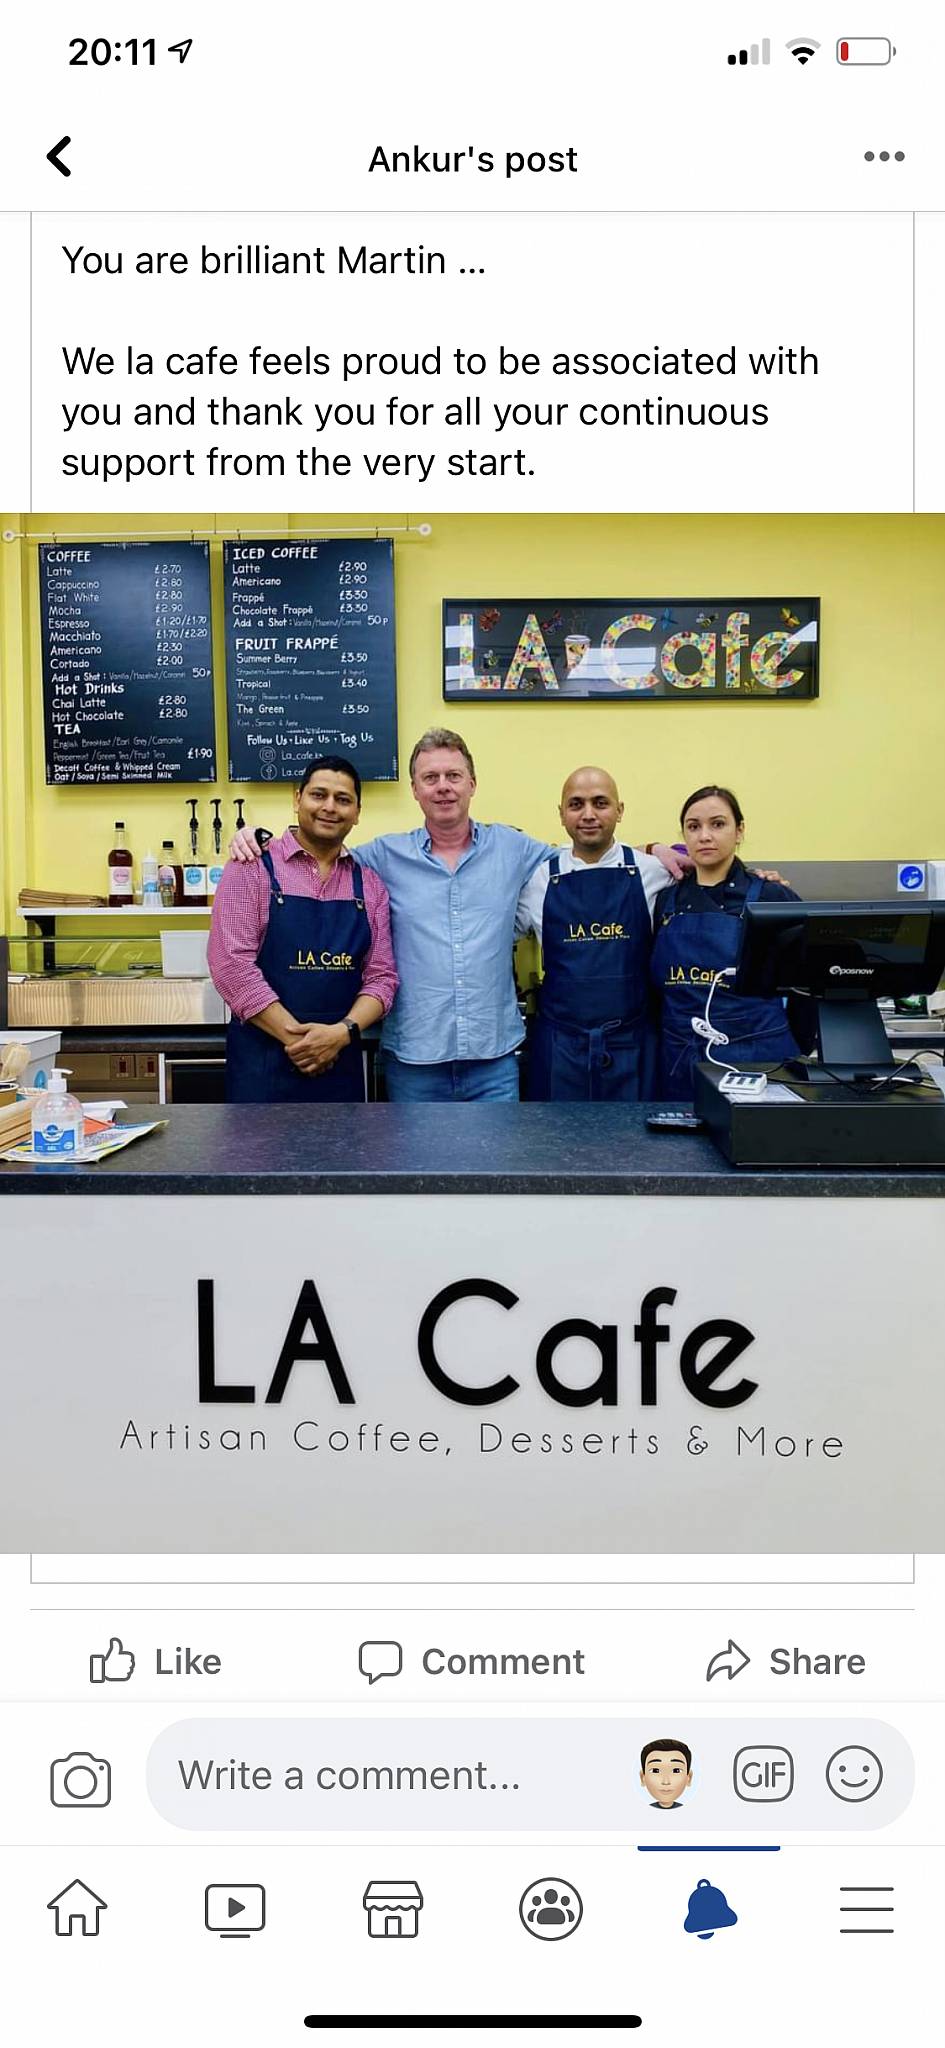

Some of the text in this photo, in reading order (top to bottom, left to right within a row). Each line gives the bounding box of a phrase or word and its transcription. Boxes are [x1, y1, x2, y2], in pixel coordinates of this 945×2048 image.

[47, 551, 91, 562] COFFEE
[232, 547, 318, 560] ICED COFFEE
[47, 566, 72, 577] Latte
[232, 563, 261, 574] Latte
[48, 580, 100, 591] Cappuccino
[232, 576, 281, 587] Americano
[48, 593, 66, 602] Flat
[74, 593, 99, 602] White
[232, 592, 265, 604] Frappé
[49, 606, 81, 616] Mocha
[232, 605, 278, 615] Chocolate
[49, 618, 90, 630] Espresso
[233, 618, 252, 628] Add
[50, 630, 101, 642] Macchiato
[235, 634, 339, 650] FRUIT FRAPPÉ
[50, 645, 101, 656] Americano
[459, 611, 806, 690] LA Cafe
[50, 659, 90, 669] Cortado
[236, 653, 272, 664] Summer
[274, 654, 297, 664] Berry
[52, 673, 69, 682] Add
[55, 682, 125, 695] Hot Drinks
[235, 678, 271, 690] Tropical
[52, 698, 74, 708] Chai
[80, 698, 106, 708] Latte
[236, 704, 254, 714] The
[258, 704, 285, 714] Green
[52, 711, 70, 723] Hot
[75, 710, 124, 721] Chocolate
[53, 723, 81, 735] TEA
[247, 731, 375, 749] Follow Us Like Us Tag Us
[84, 762, 110, 771] Coffee
[122, 762, 153, 773] Whipped
[157, 762, 181, 771] Cream
[122, 772, 152, 780] Skimmed
[156, 771, 173, 779] Milk
[569, 922, 624, 938] LA Cafe
[298, 949, 353, 966] LA Cafe
[670, 965, 685, 980] LA
[197, 1278, 759, 1408] LA Cafe
[120, 1420, 844, 1459] Artisan Coffee, Desserts & More
